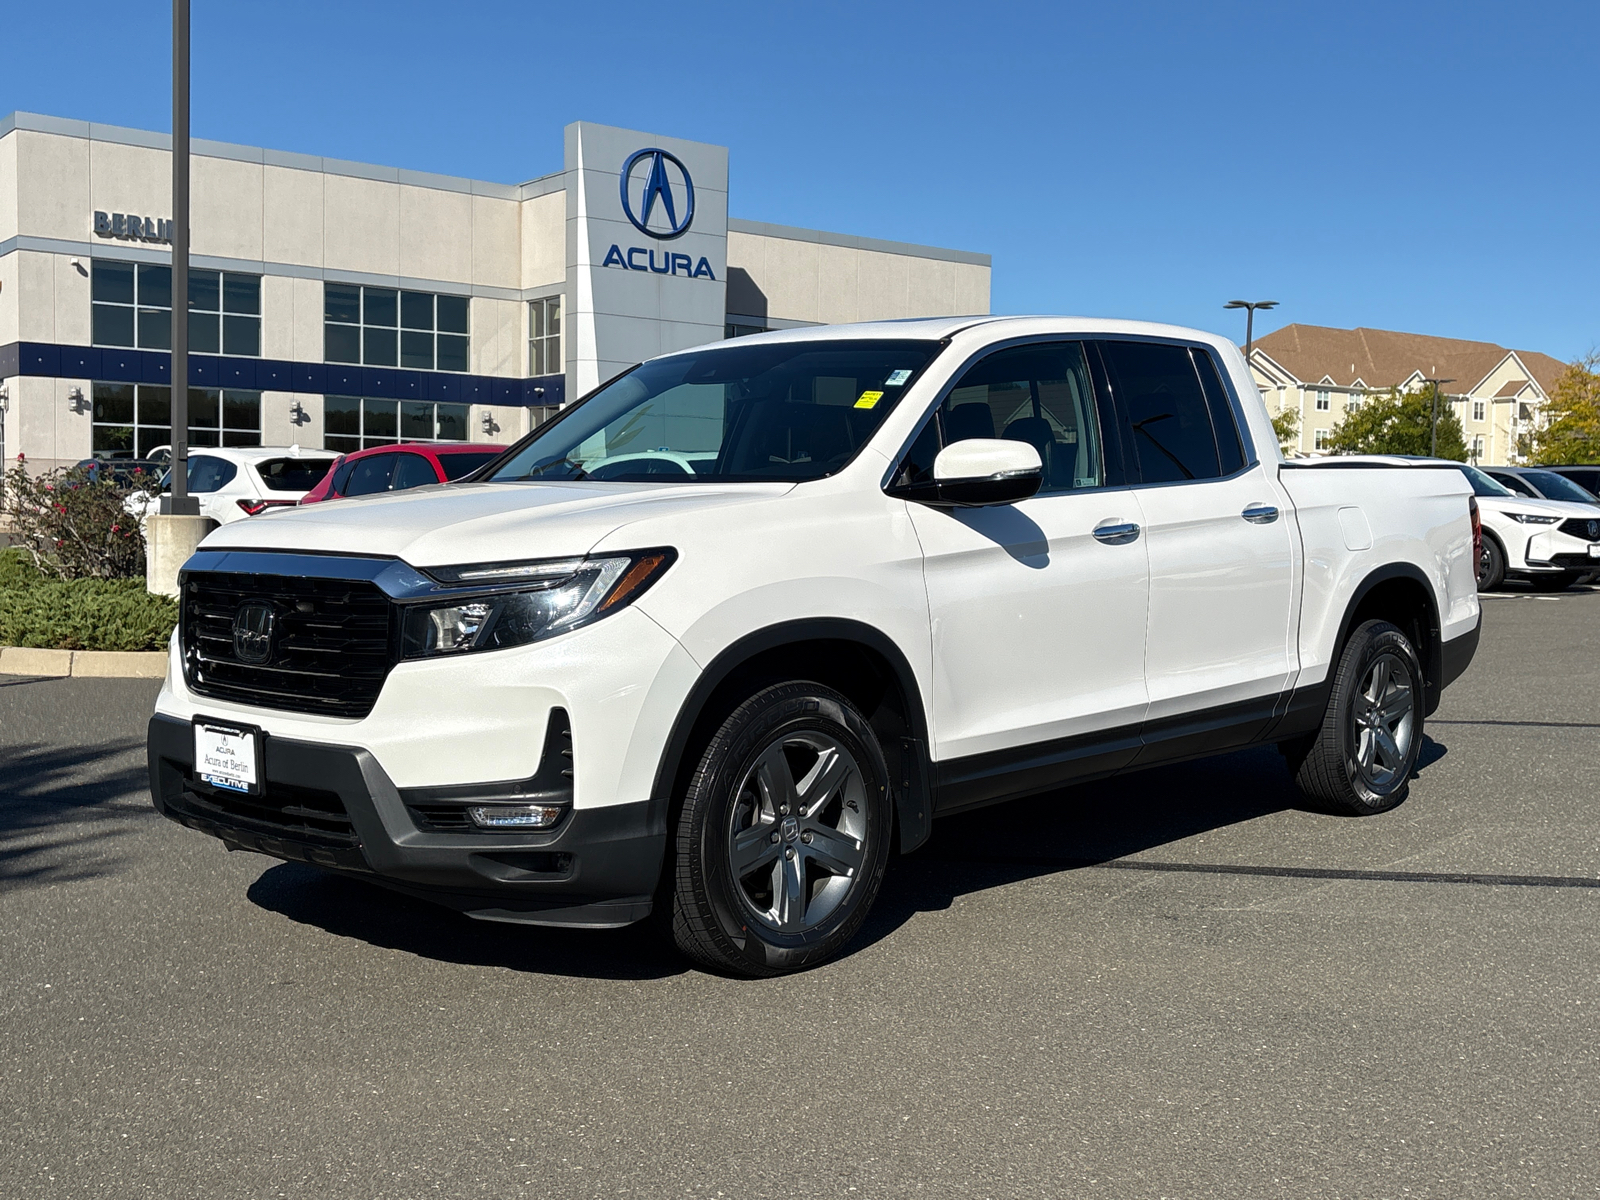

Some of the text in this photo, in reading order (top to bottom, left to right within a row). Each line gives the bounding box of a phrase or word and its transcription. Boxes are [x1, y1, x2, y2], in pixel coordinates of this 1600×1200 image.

[602, 244, 716, 281] ACURA
[215, 745, 236, 756] ACURA
[723, 700, 820, 795] ARROYO
[204, 753, 249, 773] Acura of Berlin
[201, 773, 249, 790] EXECUTIVE
